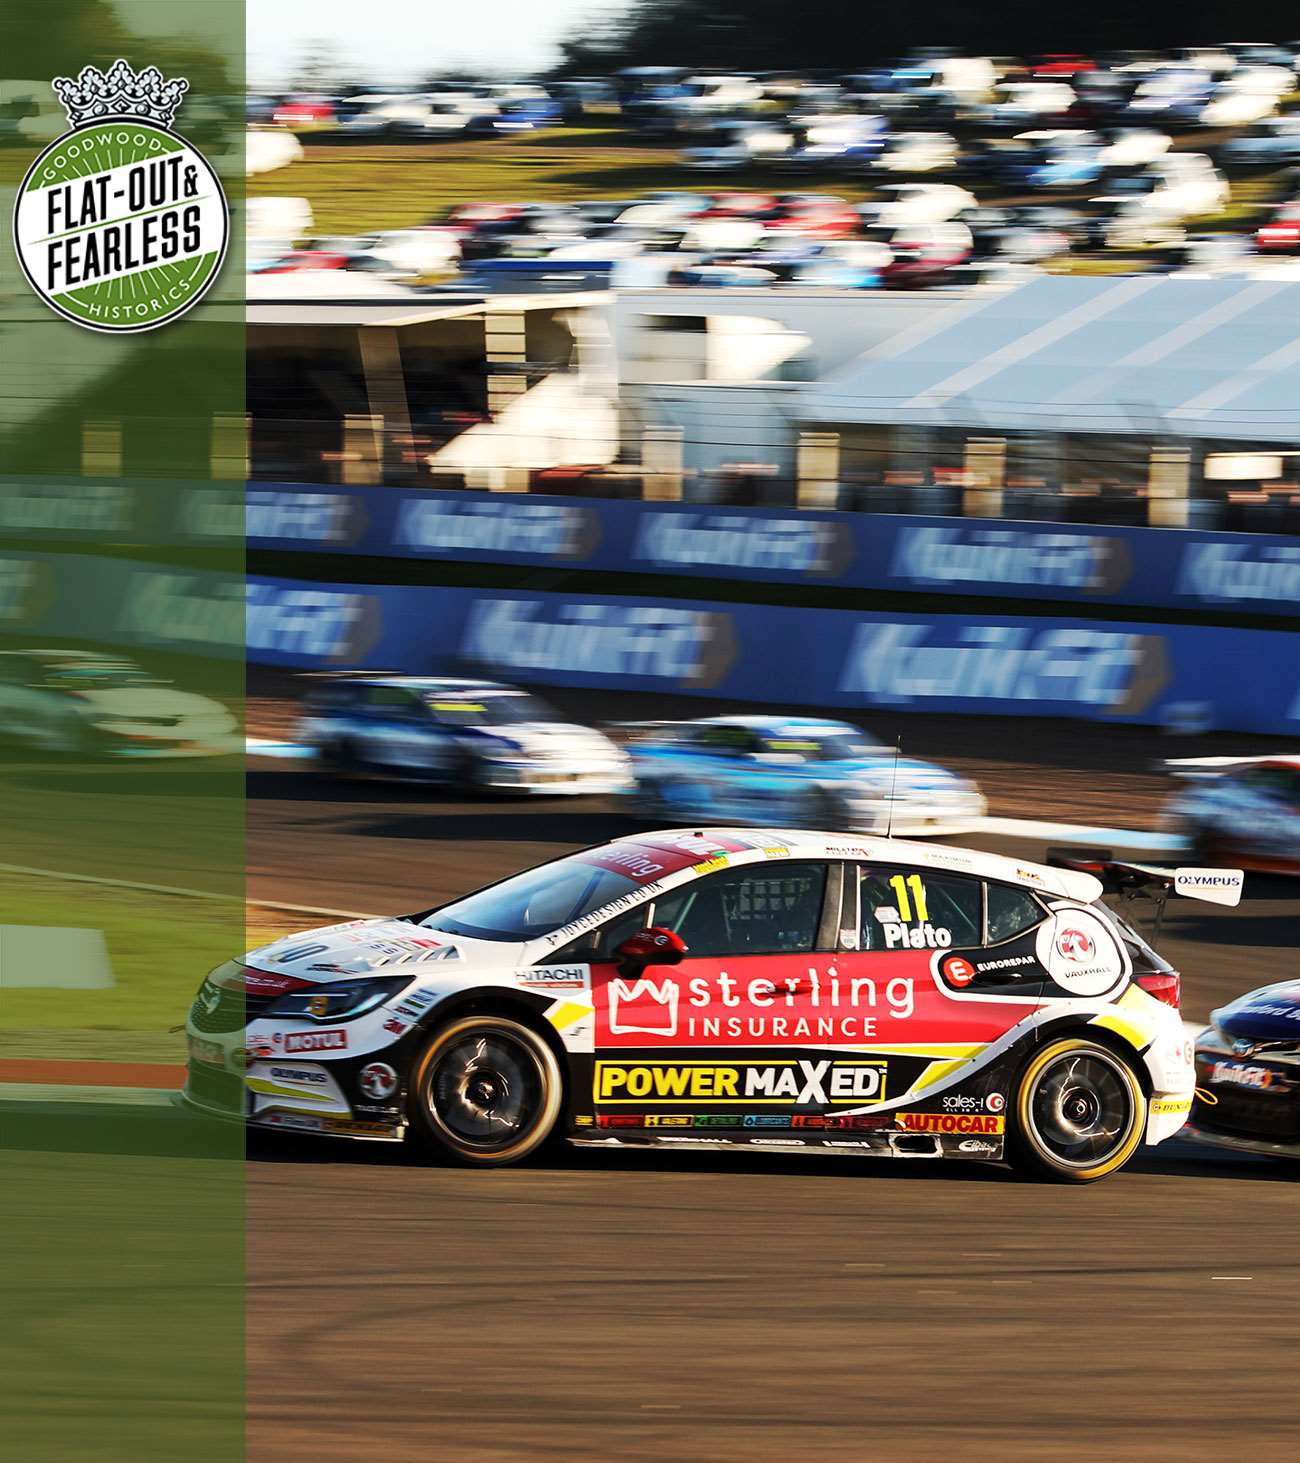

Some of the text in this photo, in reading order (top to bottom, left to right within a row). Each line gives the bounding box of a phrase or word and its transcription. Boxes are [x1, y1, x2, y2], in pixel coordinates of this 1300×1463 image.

[1177, 875, 1241, 888] OLYMPUS
[889, 873, 930, 922] 11
[883, 922, 952, 949] Plato
[976, 955, 1036, 973] EUROREPAR
[1064, 966, 1113, 979] VAUXHALL
[516, 968, 585, 981] HITACHI
[689, 966, 915, 1019] sterling
[688, 1016, 878, 1038] INSURANCE
[287, 1032, 345, 1050] MOTUL
[270, 1066, 329, 1083] OLYMPUS
[600, 1059, 881, 1104] POWER MAXED
[904, 1113, 998, 1133] AUTOCAR
